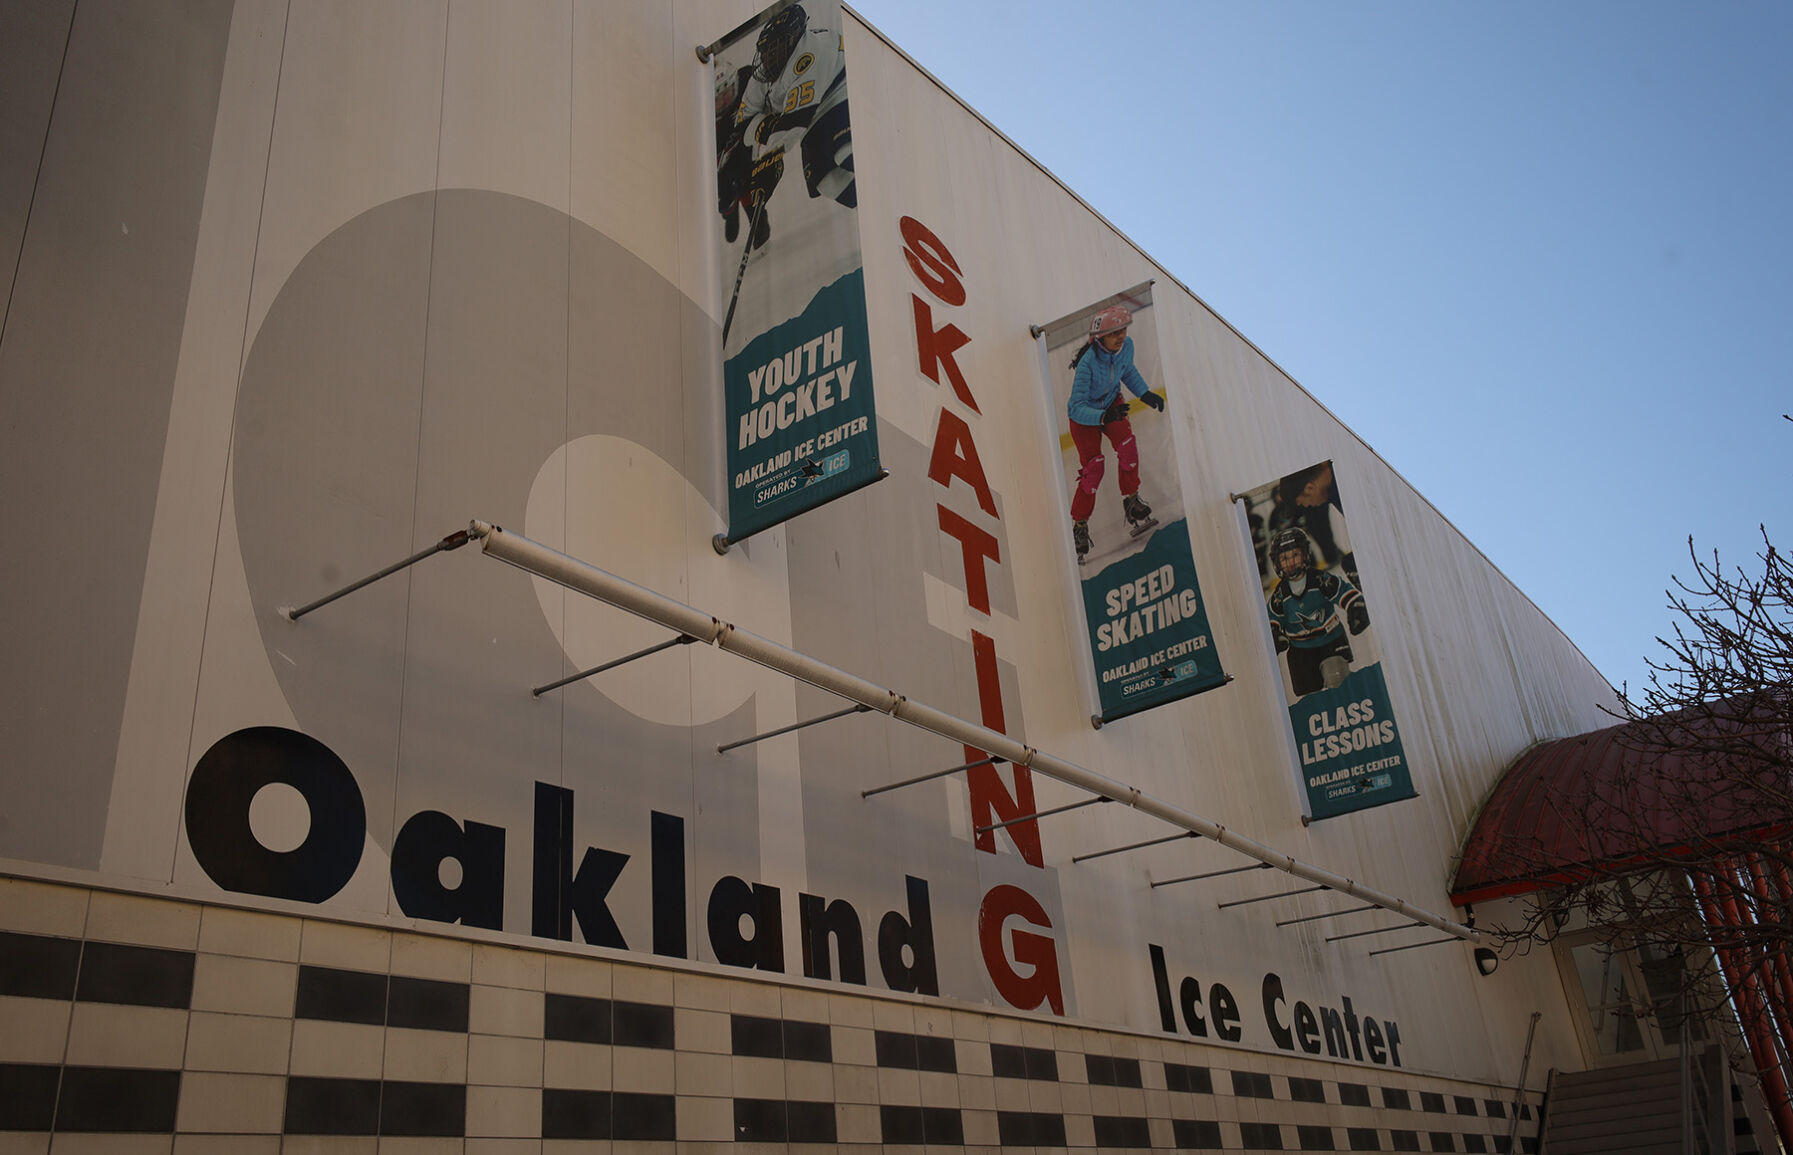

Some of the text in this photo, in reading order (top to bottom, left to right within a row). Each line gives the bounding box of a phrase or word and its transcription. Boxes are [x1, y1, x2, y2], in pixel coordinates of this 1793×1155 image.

[747, 326, 844, 404] YOUTH
[738, 360, 858, 450] HOCKEY
[735, 416, 868, 489] OAKLAND ICE CENTER
[828, 454, 847, 472] ICE
[757, 476, 798, 503] SHARKS
[1105, 564, 1175, 617] SPEED
[899, 214, 1064, 1018] SKATING
[1096, 588, 1197, 651] SKATING
[1102, 657, 1149, 683] OAKLAND
[1151, 651, 1166, 666] ICE
[1167, 635, 1208, 659] CENTER
[1180, 664, 1194, 676] ICE
[1123, 677, 1156, 695] SHARKS
[1308, 698, 1375, 736] CLASS
[1302, 720, 1395, 765] LESSONS
[1310, 768, 1350, 788] OAKLAND
[1351, 764, 1365, 777] ICE
[1366, 755, 1401, 772] CENTER
[1328, 785, 1356, 798] SHARKS
[185, 725, 1401, 1067] Oakland Ice Center
